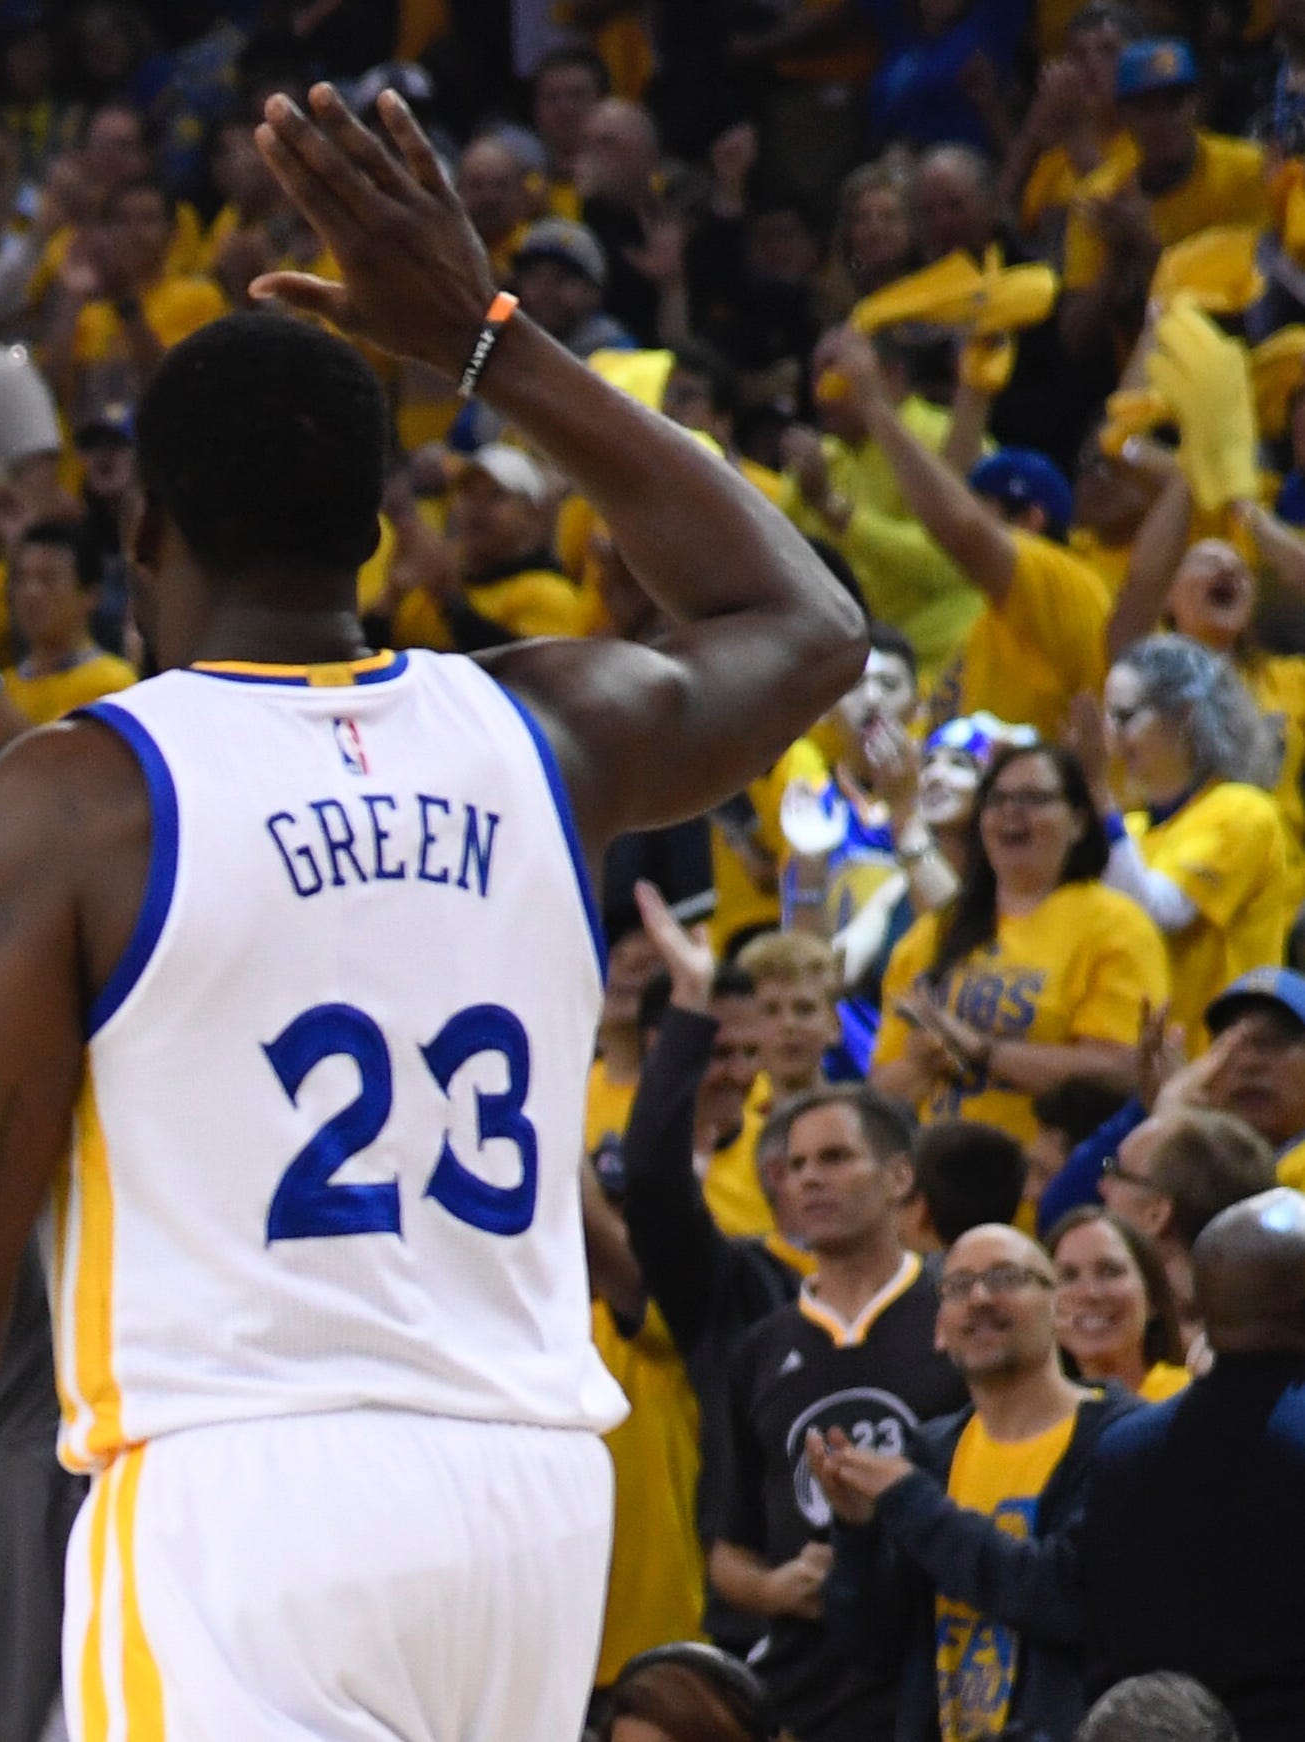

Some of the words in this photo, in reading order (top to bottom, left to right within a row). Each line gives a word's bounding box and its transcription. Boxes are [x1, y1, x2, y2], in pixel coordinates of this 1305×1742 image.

[266, 793, 500, 899] GREEN
[259, 1001, 538, 1250] 23
[852, 1416, 903, 1458] 23
